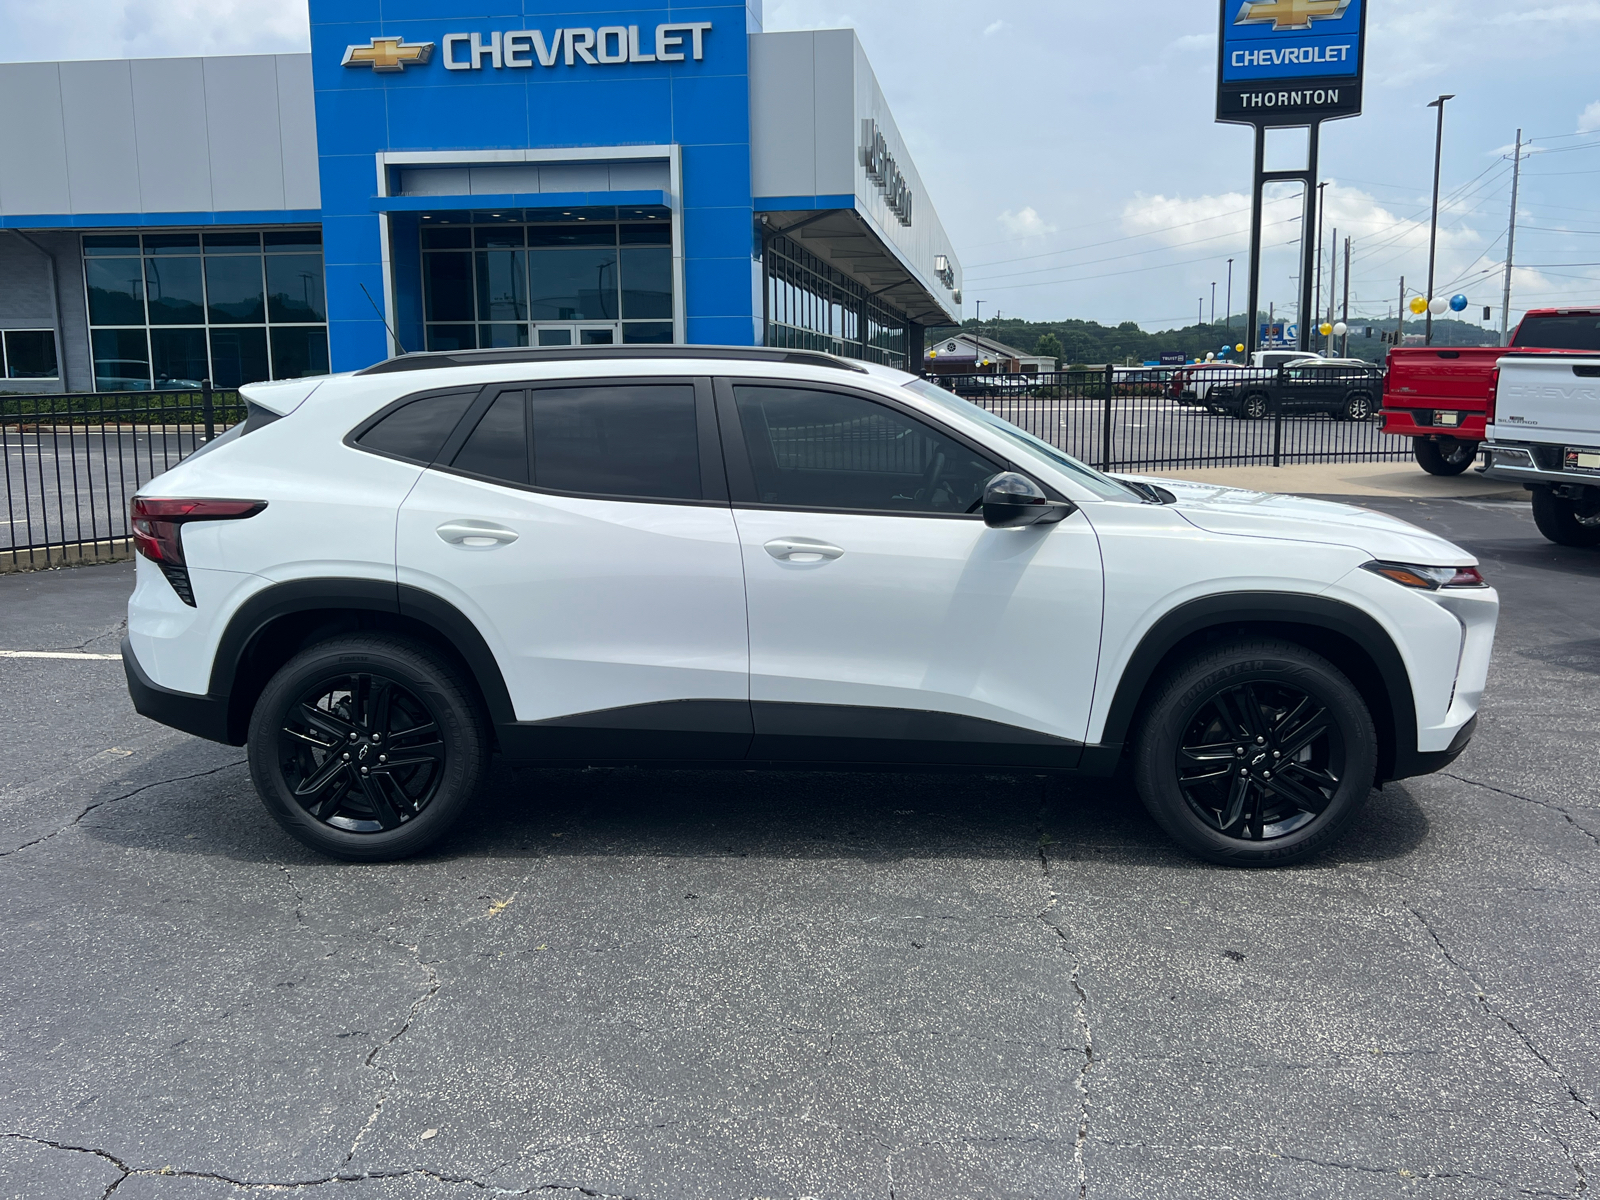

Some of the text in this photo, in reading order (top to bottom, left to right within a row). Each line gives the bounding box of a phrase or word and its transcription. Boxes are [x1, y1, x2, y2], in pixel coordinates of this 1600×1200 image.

[442, 22, 712, 70] CHEVROLET
[1231, 45, 1351, 67] CHEVROLET
[1240, 89, 1339, 108] THORNTON
